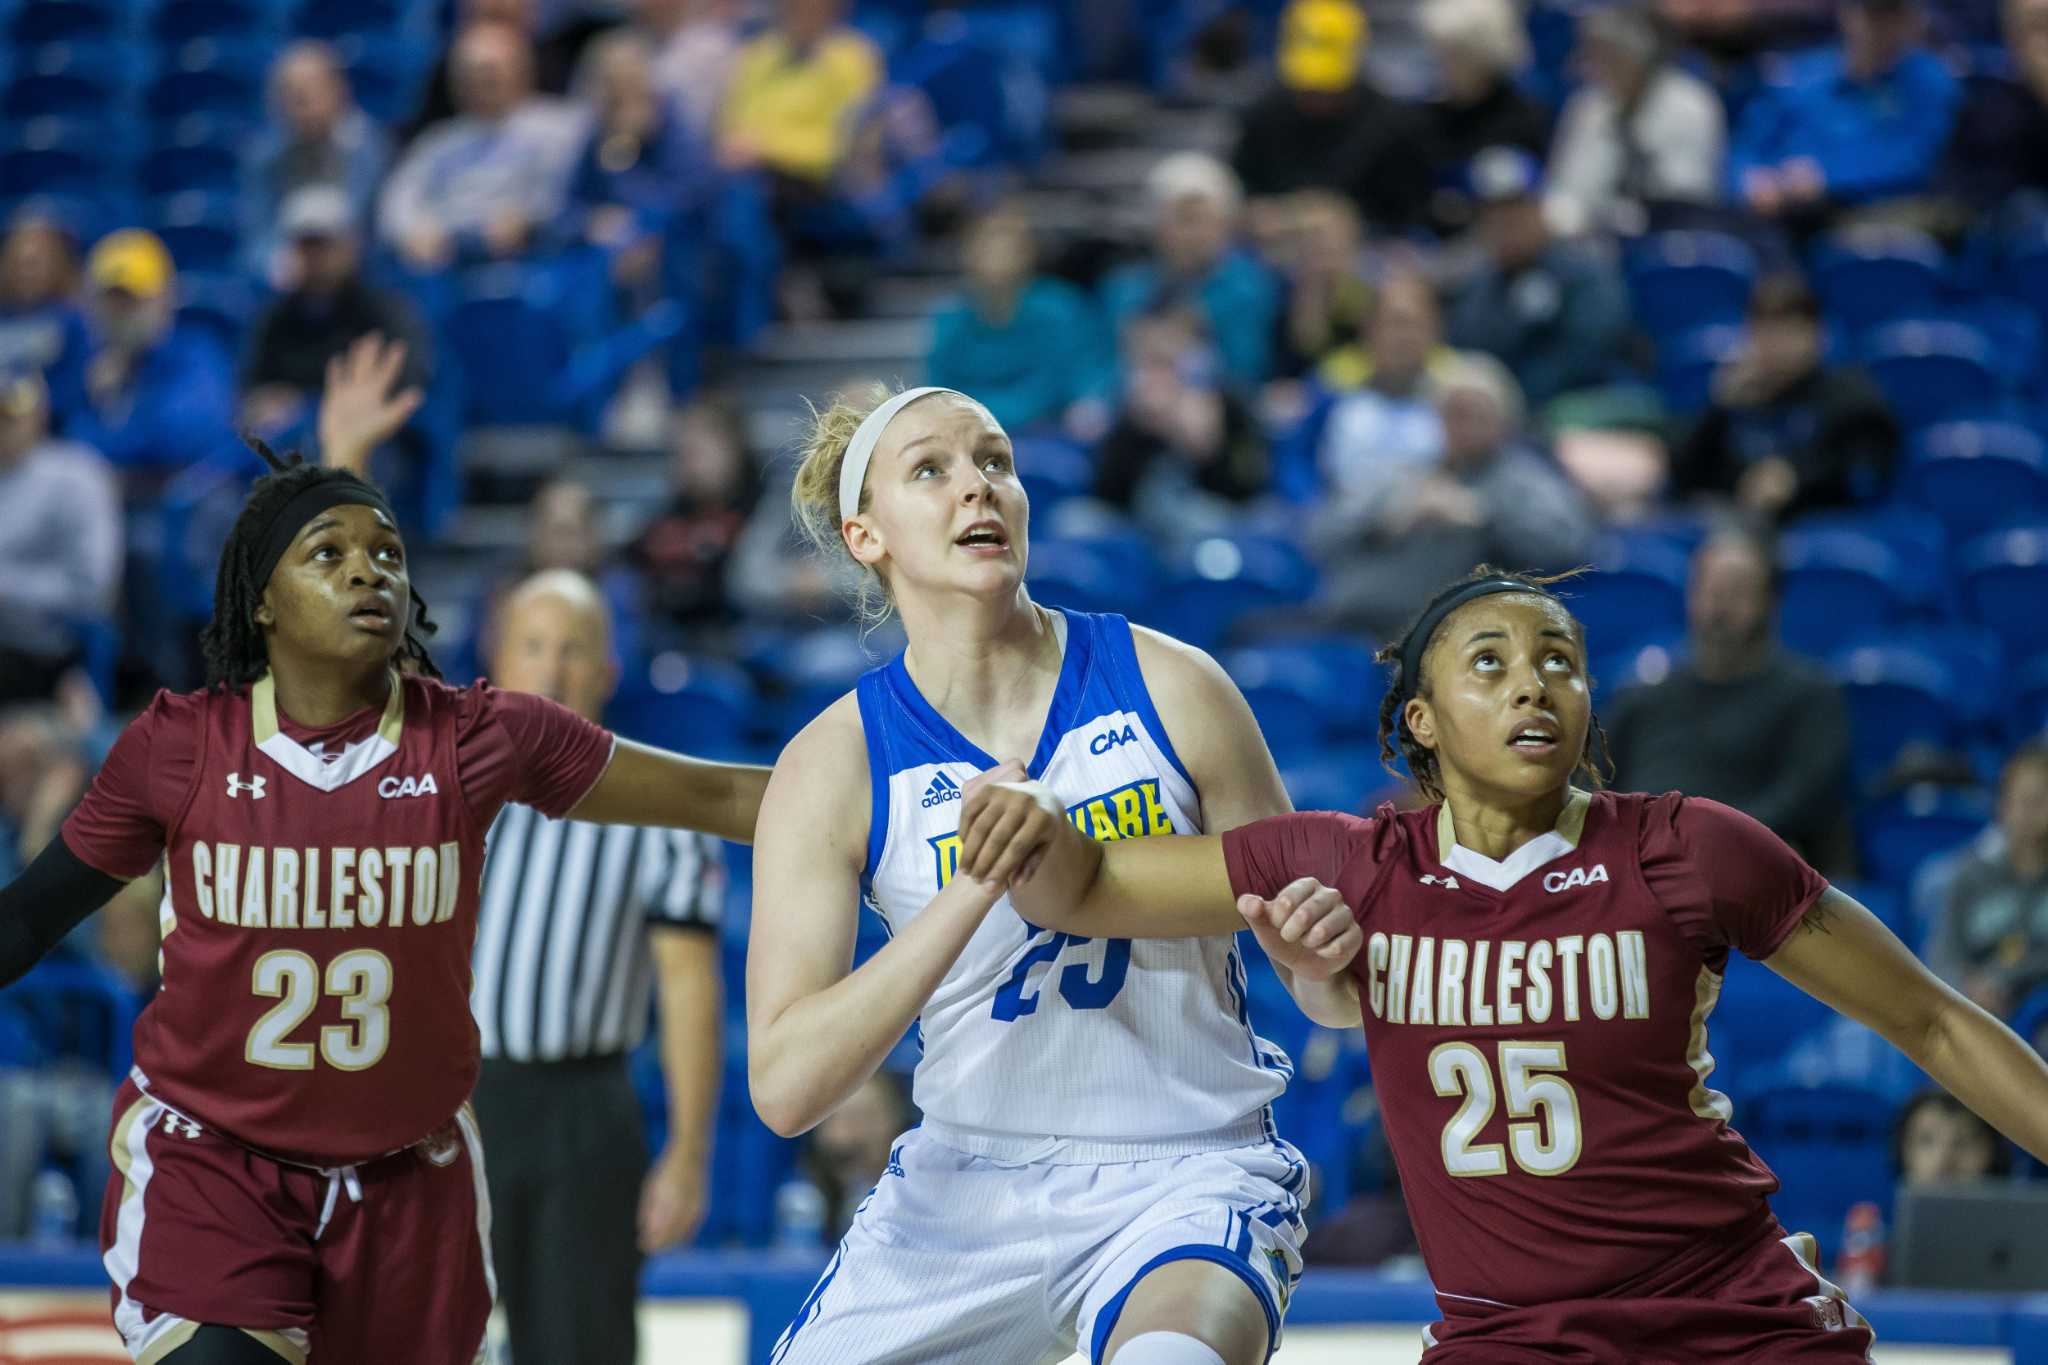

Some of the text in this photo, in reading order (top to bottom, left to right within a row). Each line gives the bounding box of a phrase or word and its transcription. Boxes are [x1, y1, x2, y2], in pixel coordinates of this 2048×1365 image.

[1090, 725, 1138, 755] CAA
[378, 773, 438, 798] CAA
[921, 788, 962, 808] adida
[192, 840, 460, 928] CHARLESTON
[1543, 863, 1609, 893] CAA
[1368, 930, 1649, 1026] CHARLESTON
[245, 949, 393, 1071] 23
[1427, 1040, 1582, 1177] 25
